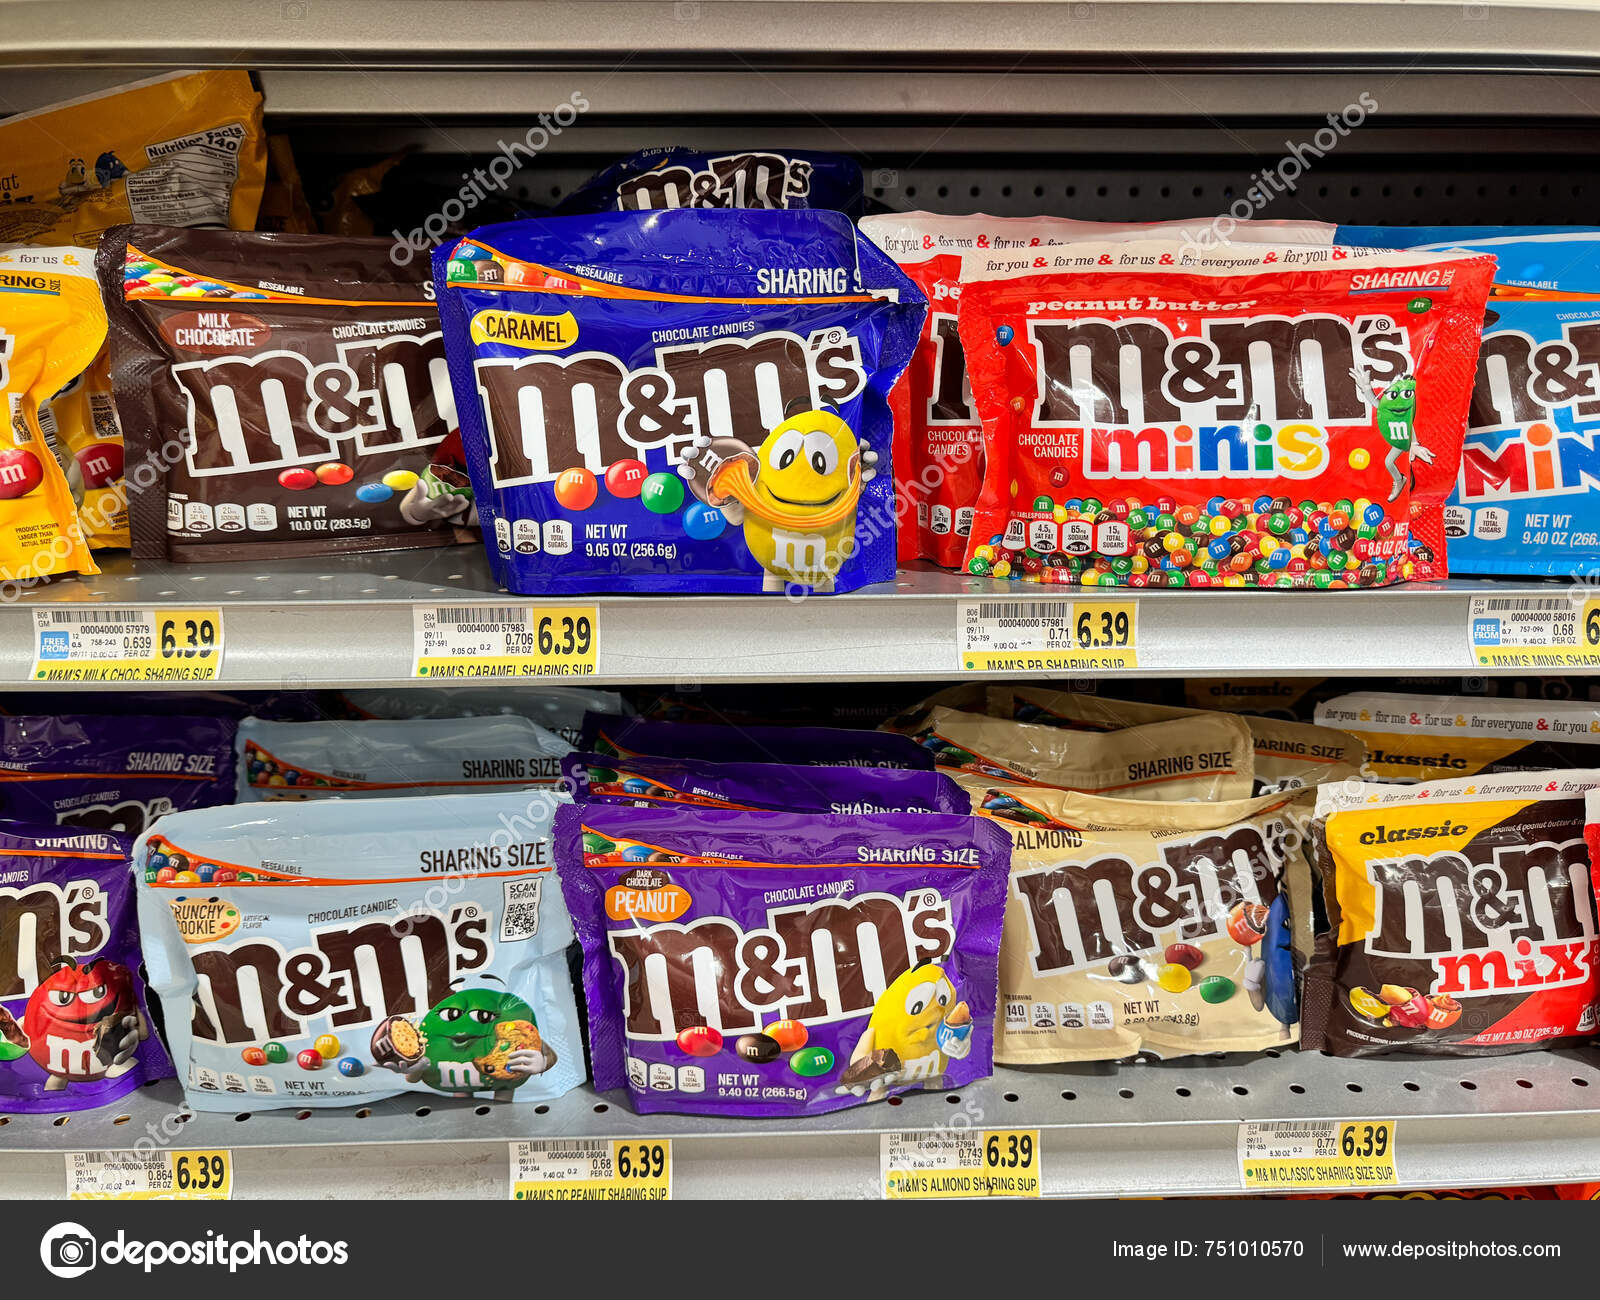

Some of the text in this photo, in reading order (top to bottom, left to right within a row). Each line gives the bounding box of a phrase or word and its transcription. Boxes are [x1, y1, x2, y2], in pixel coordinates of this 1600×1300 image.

[148, 127, 242, 157] Nutrition Facts
[20, 253, 79, 266] for us &
[986, 260, 1002, 272] for
[1005, 262, 1029, 272] you
[1032, 256, 1049, 268] &
[1054, 256, 1068, 267] for
[1071, 257, 1094, 266] me
[1098, 253, 1113, 265] &
[1119, 255, 1135, 265] for
[1138, 256, 1155, 265] us
[1158, 253, 1175, 265] &
[1201, 256, 1259, 267] everyone
[1263, 252, 1278, 263] &
[1283, 250, 1302, 262] for
[1303, 251, 1328, 264] you
[1332, 247, 1347, 260] &
[575, 265, 623, 285] RESEALABLE
[756, 268, 848, 296] SHARING
[1350, 270, 1440, 291] SHARING
[258, 280, 305, 296] RESEALABLE
[1027, 295, 1258, 315] peanut butter
[197, 312, 230, 328] MILK
[332, 318, 426, 340] CHOCOLATE CANDIES
[486, 315, 566, 344] CARAMEL
[651, 320, 755, 344] CHOCOLATE CANDIES
[175, 327, 256, 348] CHOCOLATE
[1025, 311, 1414, 429] m&m's
[473, 325, 868, 490] m&m's
[1018, 433, 1078, 446] CHOCOLATE
[928, 443, 969, 456] CANDIES
[1033, 446, 1078, 458] CANDIES
[1083, 421, 1330, 480] minis
[287, 506, 312, 519] NET
[314, 506, 327, 519] WT
[1525, 513, 1572, 528] NET WT
[289, 517, 372, 532] 10.0 OZ (283.5g)
[585, 524, 627, 539] NET WT
[585, 543, 677, 560] 9.05 OZ (256.6g)
[999, 619, 1064, 627] 000040000 57981
[1511, 613, 1576, 622] 000040000 58016
[81, 625, 149, 634] 000040000 57979
[457, 624, 525, 632] 000040000 57983
[538, 617, 591, 655] 6.39
[1049, 629, 1069, 640] 0.71
[1077, 612, 1129, 649] 6.39
[1553, 624, 1574, 635] 0.68
[123, 637, 151, 649] 0.639
[161, 620, 214, 658] 6.39
[505, 634, 533, 645] 0.706
[48, 668, 214, 680] M&M'S MILK CHOC. SHARING SUP
[430, 665, 464, 677] M&M'S
[522, 665, 569, 676] SHARING
[572, 664, 593, 675] SUP
[126, 753, 216, 774] SHARING SIZE
[462, 758, 561, 779] SHARING SIZE
[1127, 751, 1233, 781] SHARING SIZE
[1417, 790, 1430, 799] &
[1432, 789, 1446, 798] for
[1448, 788, 1462, 796] us
[1463, 785, 1477, 795] &
[1480, 785, 1494, 795] for
[1495, 782, 1542, 793] everyone
[1545, 781, 1558, 792] &
[1562, 781, 1577, 792] for
[1578, 782, 1597, 791] you
[1015, 830, 1083, 850] ALMOND
[1359, 820, 1468, 845] classic
[420, 842, 546, 873] SHARING SIZE
[857, 845, 980, 865] SHARING SIZE
[636, 869, 652, 878] DARK
[509, 883, 536, 893] SCAN
[625, 877, 663, 888] CHOCOLATE
[764, 880, 856, 905] CHOCOLATE CANDIES
[614, 891, 679, 914] PEANUT
[307, 898, 399, 925] CHOCOLATE CANDIES
[607, 888, 957, 1041] m&m's
[1006, 1005, 1025, 1017] 140
[1123, 1000, 1159, 1015] NET WT
[285, 1080, 305, 1092] NET
[308, 1080, 325, 1090] WT
[718, 1074, 760, 1086] NET WT
[718, 1088, 807, 1100] 9.40 OZ (266.5g)
[1317, 1139, 1335, 1149] 0.77
[1342, 1125, 1388, 1157] 6.39
[959, 1148, 983, 1159] 0.743
[987, 1135, 1033, 1168] 6.39
[592, 1159, 611, 1169] 0.68
[618, 1145, 665, 1178] 6.39
[148, 1170, 173, 1180] 0.864
[177, 1156, 225, 1189] 6.39
[1255, 1167, 1393, 1182] M& M CLASSIC SHARING SIZE SUP
[898, 1177, 1036, 1193] M&M'S ALMOND SHARING SUP
[525, 1188, 667, 1200] M&M'S DC PEANUT SHARING SUP
